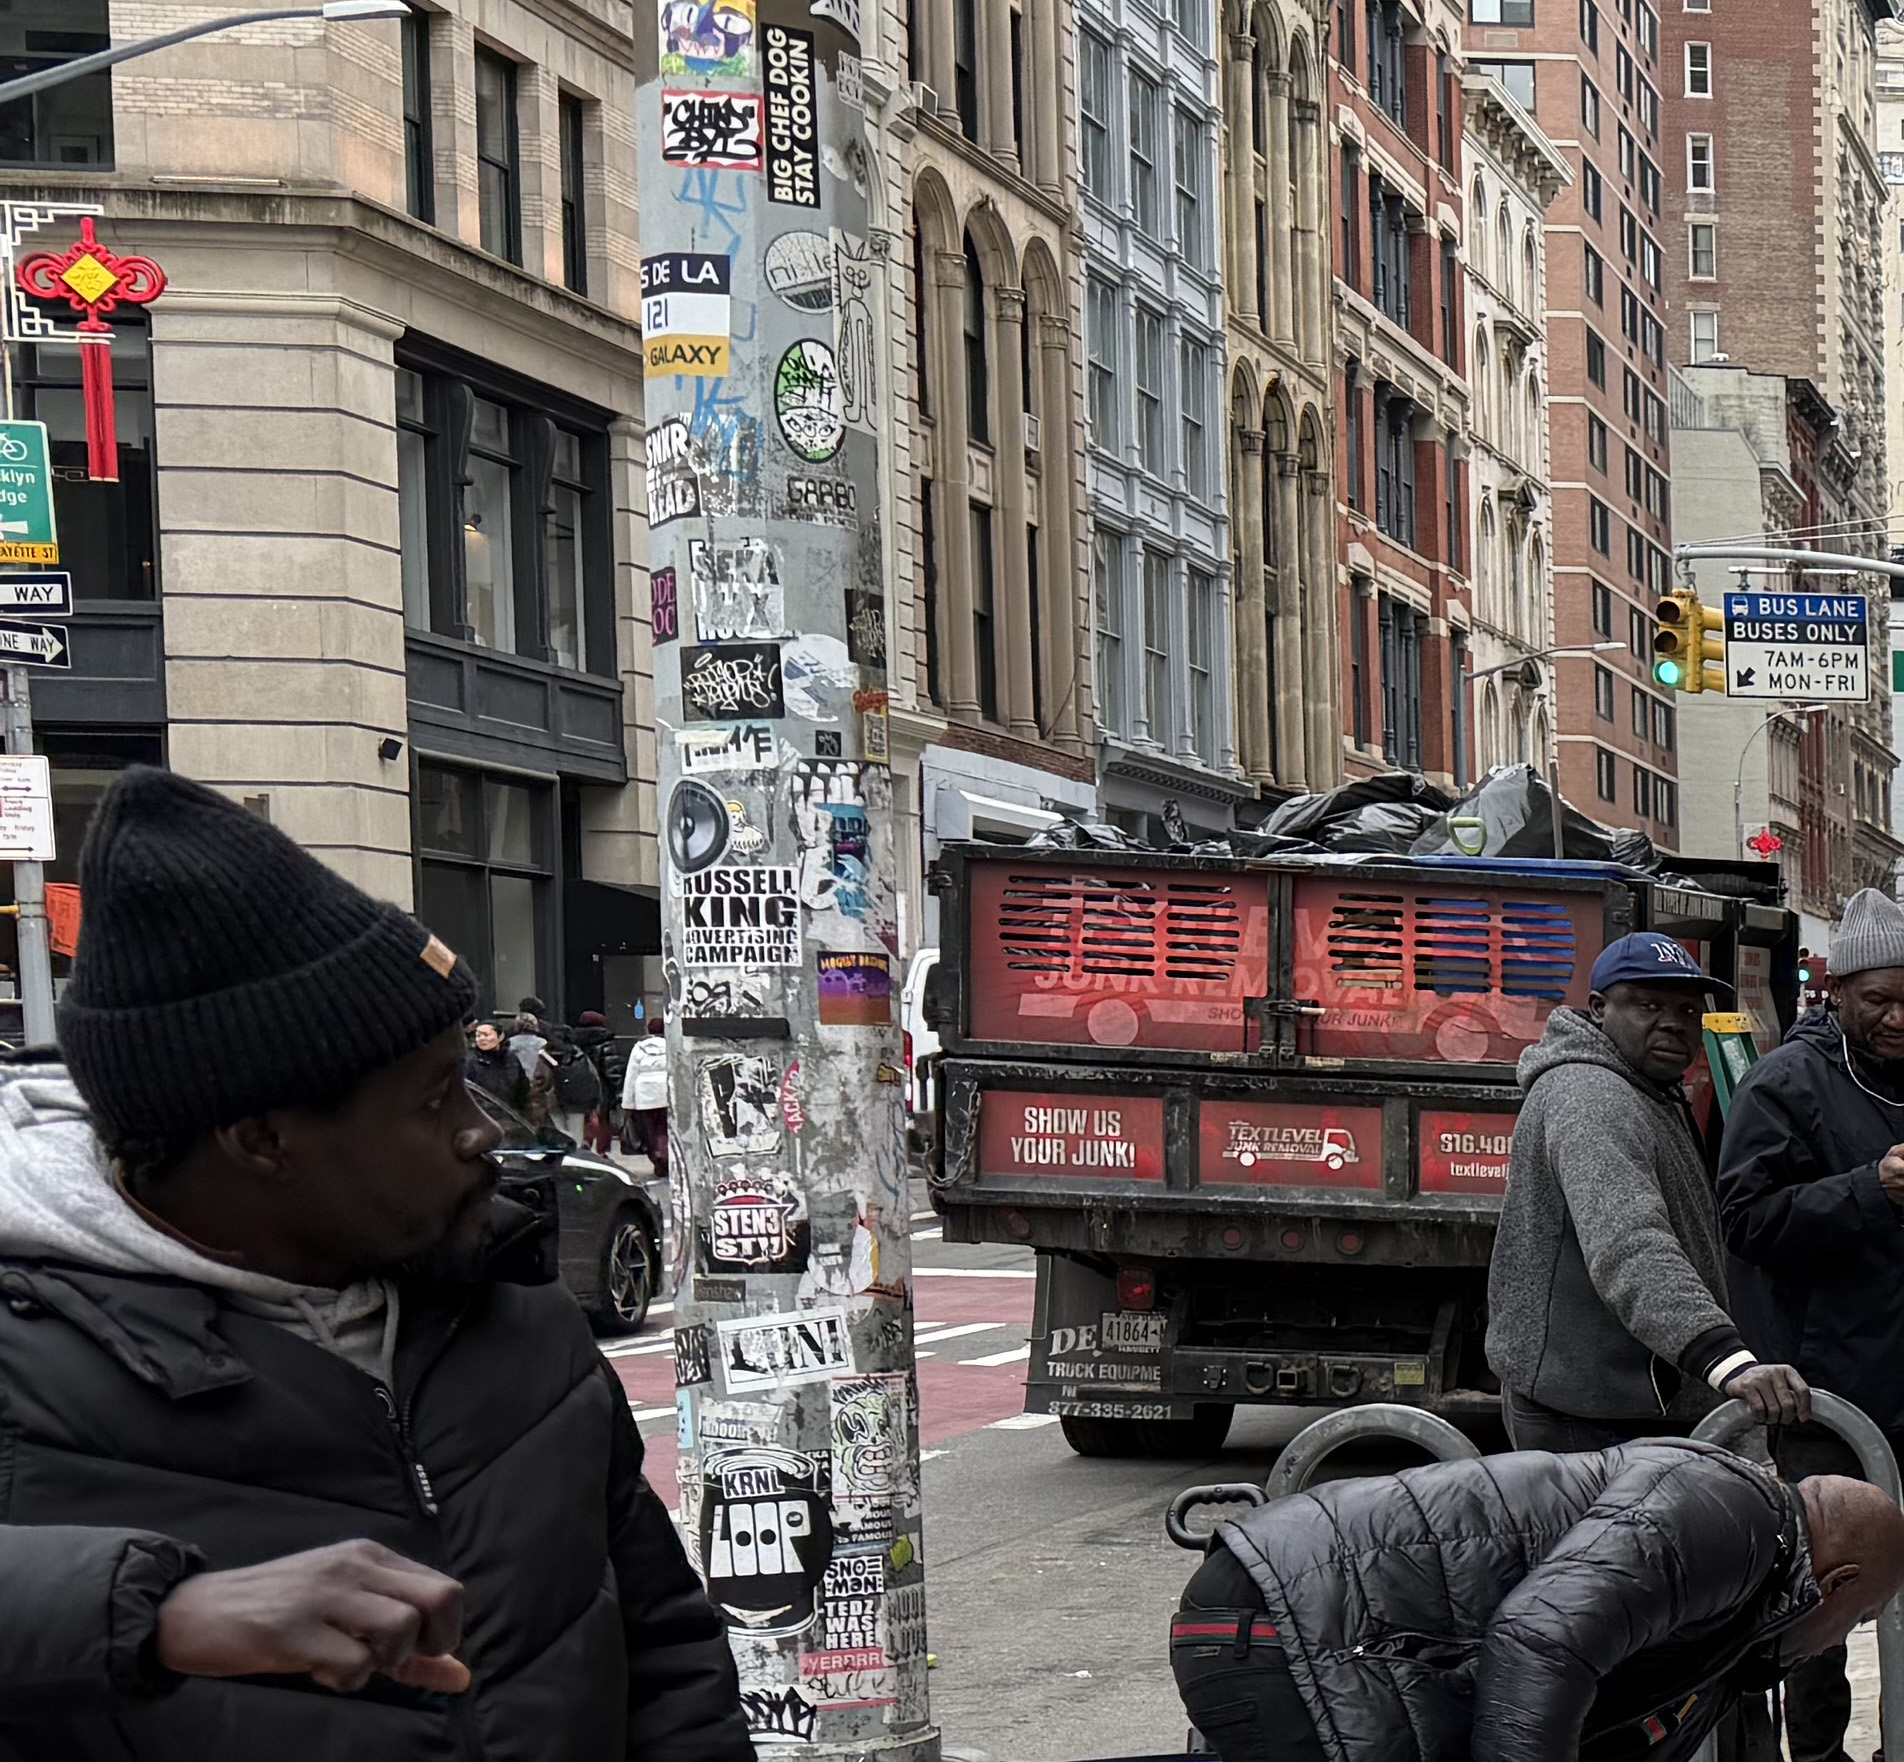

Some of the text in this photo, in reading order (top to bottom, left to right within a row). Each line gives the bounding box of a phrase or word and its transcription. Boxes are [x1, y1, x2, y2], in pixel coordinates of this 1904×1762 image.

[766, 28, 794, 202] BIG CHEF DOG
[789, 39, 815, 205] STAY COOKIN
[653, 261, 670, 286] DE
[681, 260, 720, 284] LA
[650, 344, 720, 367] GALAXY
[645, 421, 689, 470] SNKR
[14, 585, 54, 602] WAY
[1759, 597, 1859, 618] BUS LANE
[1733, 621, 1857, 642] BUSES ONLY
[30, 636, 54, 653] WAY
[1764, 650, 1859, 669] 7AM-6PM
[1769, 673, 1855, 691] MON-FRI
[684, 869, 797, 895] RUSSELL
[684, 895, 798, 928] KING
[685, 929, 798, 944] ADVERTISING
[685, 946, 798, 964] CAMPAIGN
[1024, 1106, 1121, 1137] SHOW US
[1228, 1125, 1323, 1145] TEXTLEVEL
[1011, 1136, 1135, 1168] YOUR JUNK!
[1226, 1140, 1321, 1155] JUNK REMOVAL
[714, 1208, 780, 1236] STEN3
[1047, 1361, 1095, 1379] TRUCK
[824, 1599, 875, 1617] TEDZ
[825, 1615, 874, 1633] WAS
[825, 1631, 876, 1650] HERE
